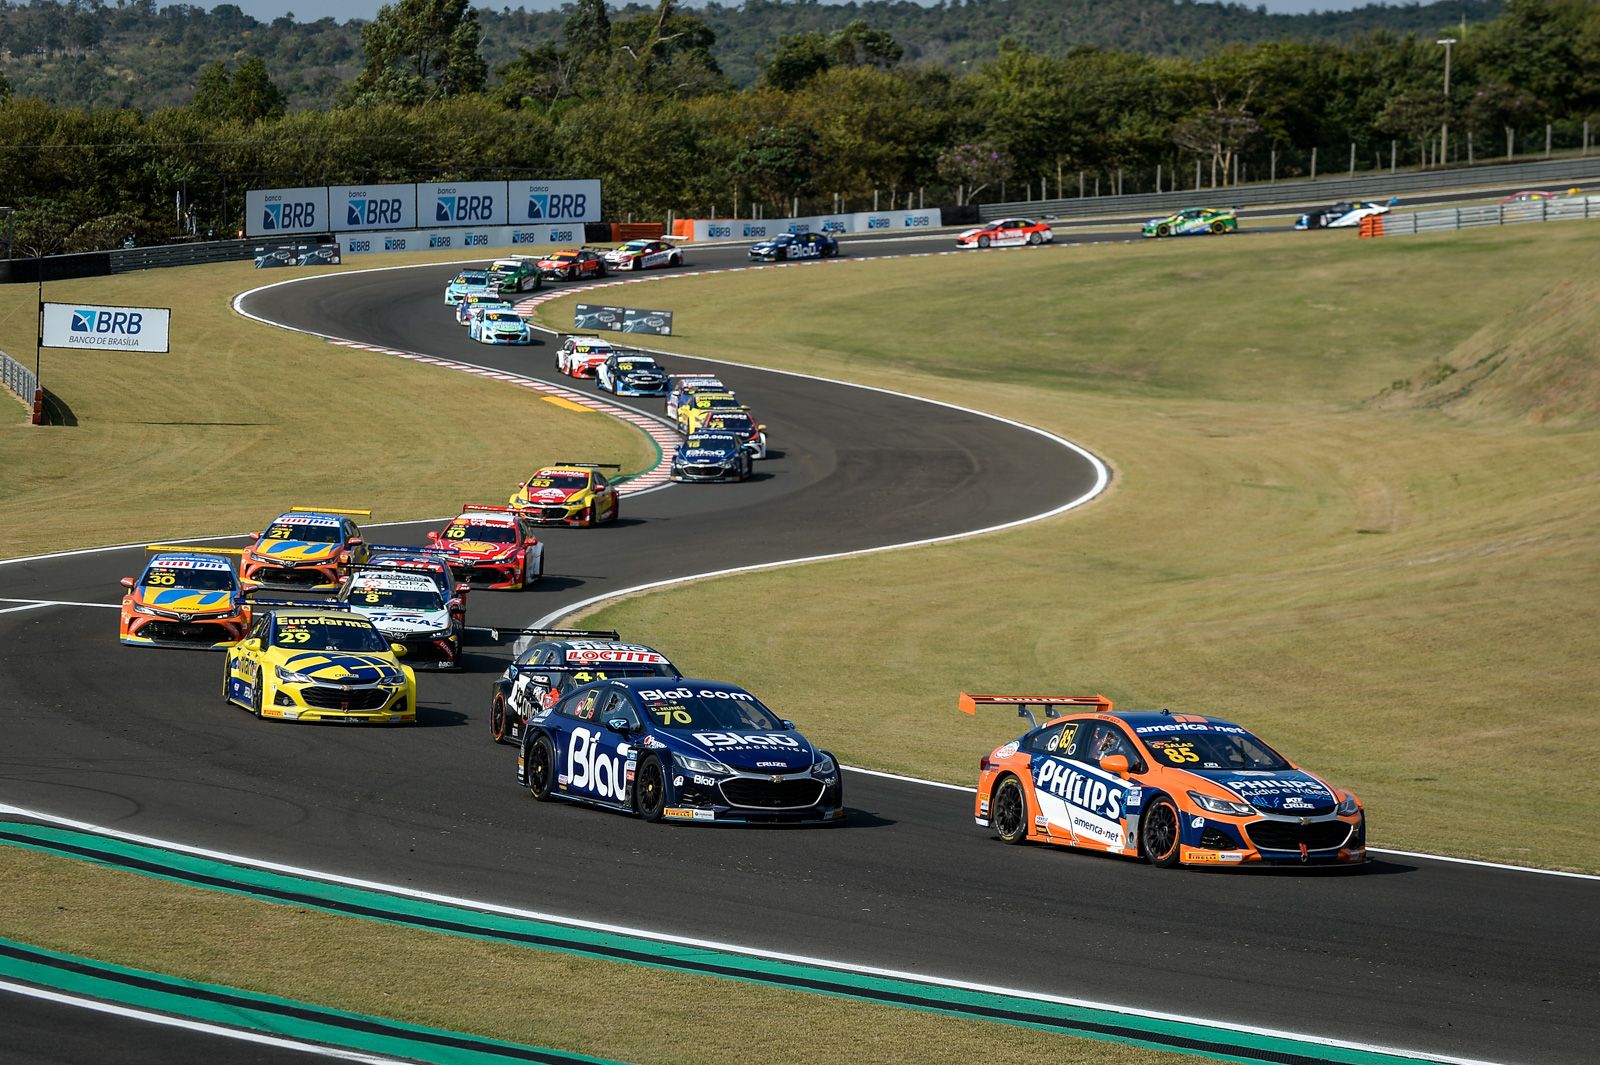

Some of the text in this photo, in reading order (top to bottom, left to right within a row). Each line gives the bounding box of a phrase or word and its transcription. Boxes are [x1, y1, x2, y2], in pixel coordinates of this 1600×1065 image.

[348, 190, 367, 198] banco
[437, 187, 456, 195] banco
[264, 194, 282, 202] banco
[456, 195, 493, 221] BRB
[548, 193, 586, 219] BRB
[281, 202, 315, 229] BRB
[366, 199, 402, 225] BRB
[558, 231, 573, 242] BRB
[716, 226, 731, 237] BRB
[750, 226, 766, 237] BRB
[437, 236, 451, 247] BRB
[473, 234, 488, 246] BRB
[520, 232, 535, 243] BRB
[356, 240, 370, 252] BRB
[392, 239, 406, 250] BRB
[96, 311, 143, 335] BRB
[68, 335, 139, 347] BANCO DE BRASÍLIA
[270, 531, 291, 539] 21
[447, 529, 466, 538] 10
[148, 575, 176, 585] 30
[387, 580, 428, 588] COPA
[365, 594, 379, 603] 8
[276, 617, 373, 629] Eurofarma
[368, 616, 444, 629] OPAGAZ
[278, 632, 311, 643] 29
[568, 650, 660, 663] LOCTITE
[574, 672, 608, 682] 41
[655, 710, 692, 725] 70
[1059, 729, 1075, 748] 85
[1163, 747, 1200, 764] 85
[1037, 759, 1122, 820] PHILIPS
[1227, 780, 1323, 790] PHILIPS
